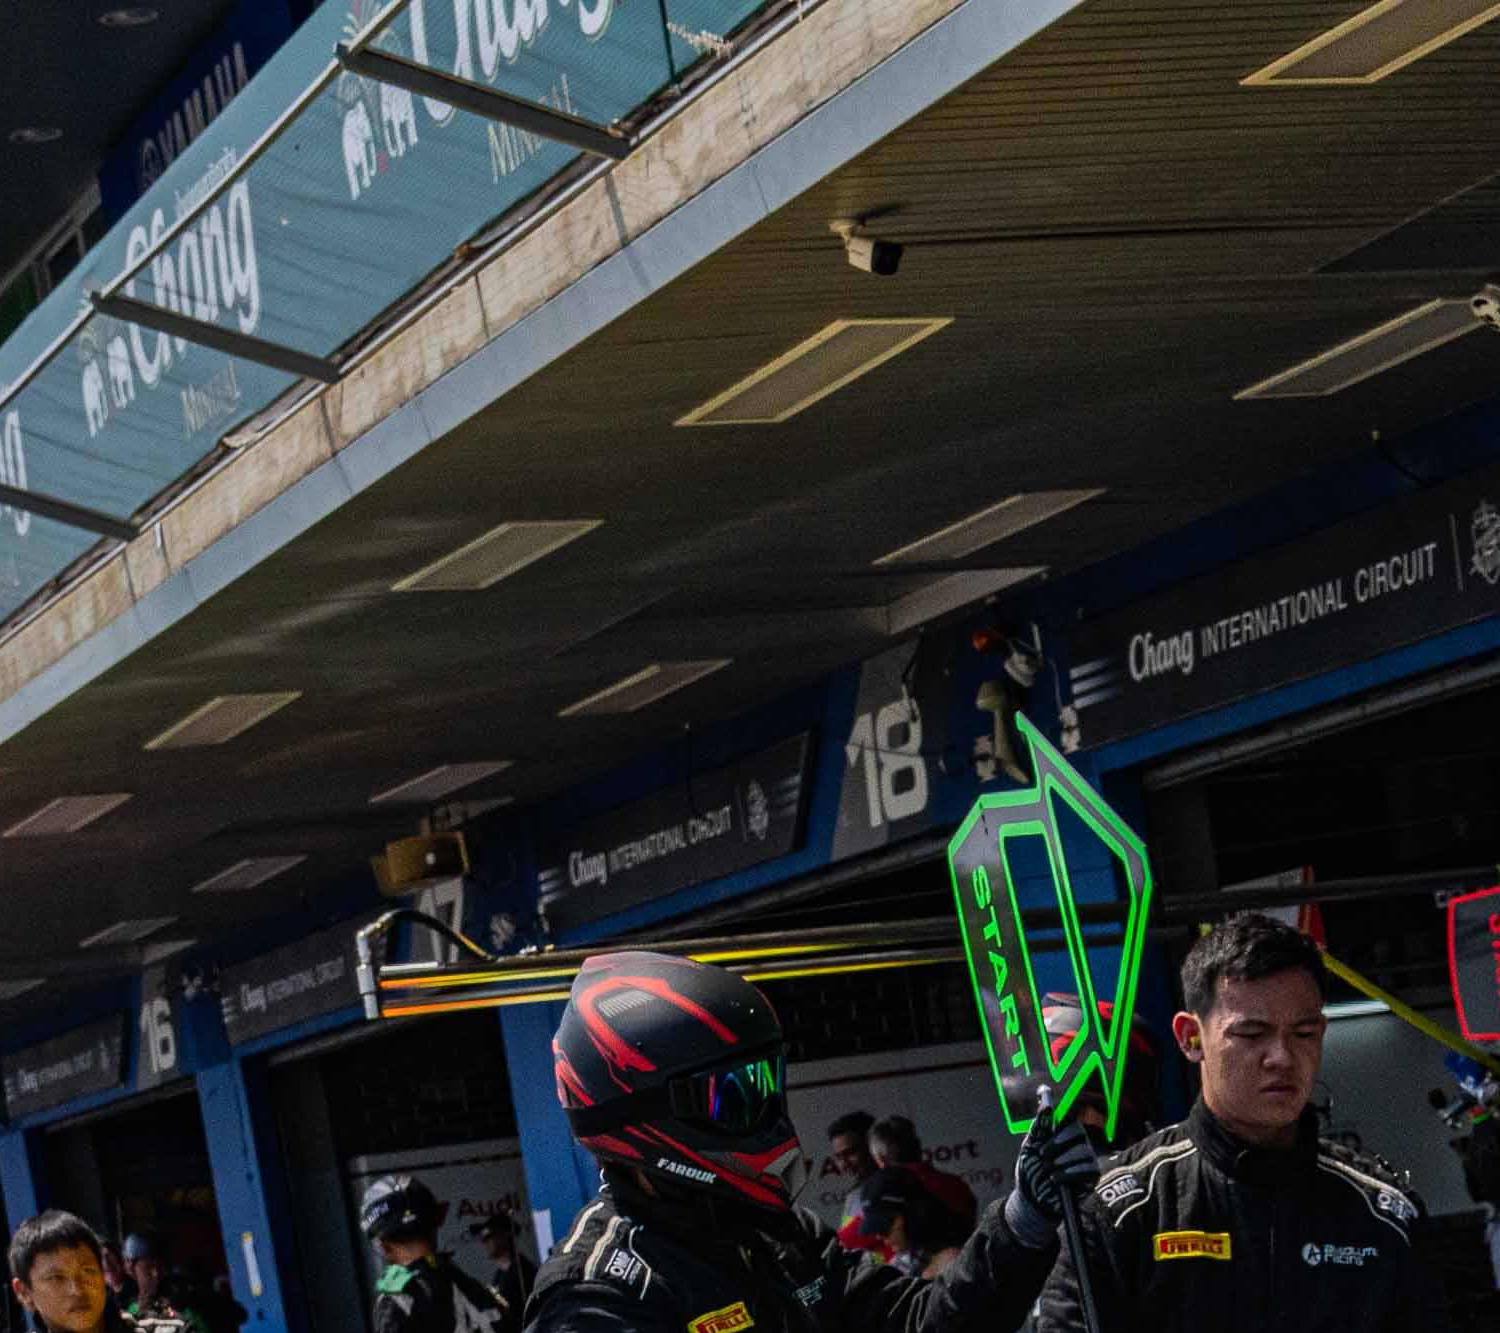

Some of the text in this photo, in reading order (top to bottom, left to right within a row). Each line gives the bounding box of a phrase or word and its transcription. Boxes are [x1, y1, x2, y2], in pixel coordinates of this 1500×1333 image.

[1129, 542, 1437, 682] Chang INTERNATIONAL CIRCUIT
[845, 699, 929, 828] 18
[971, 864, 1032, 1077] START
[140, 997, 177, 1074] 16
[657, 1157, 717, 1185] FAROUK
[1159, 1239, 1224, 1255] PIRELLI
